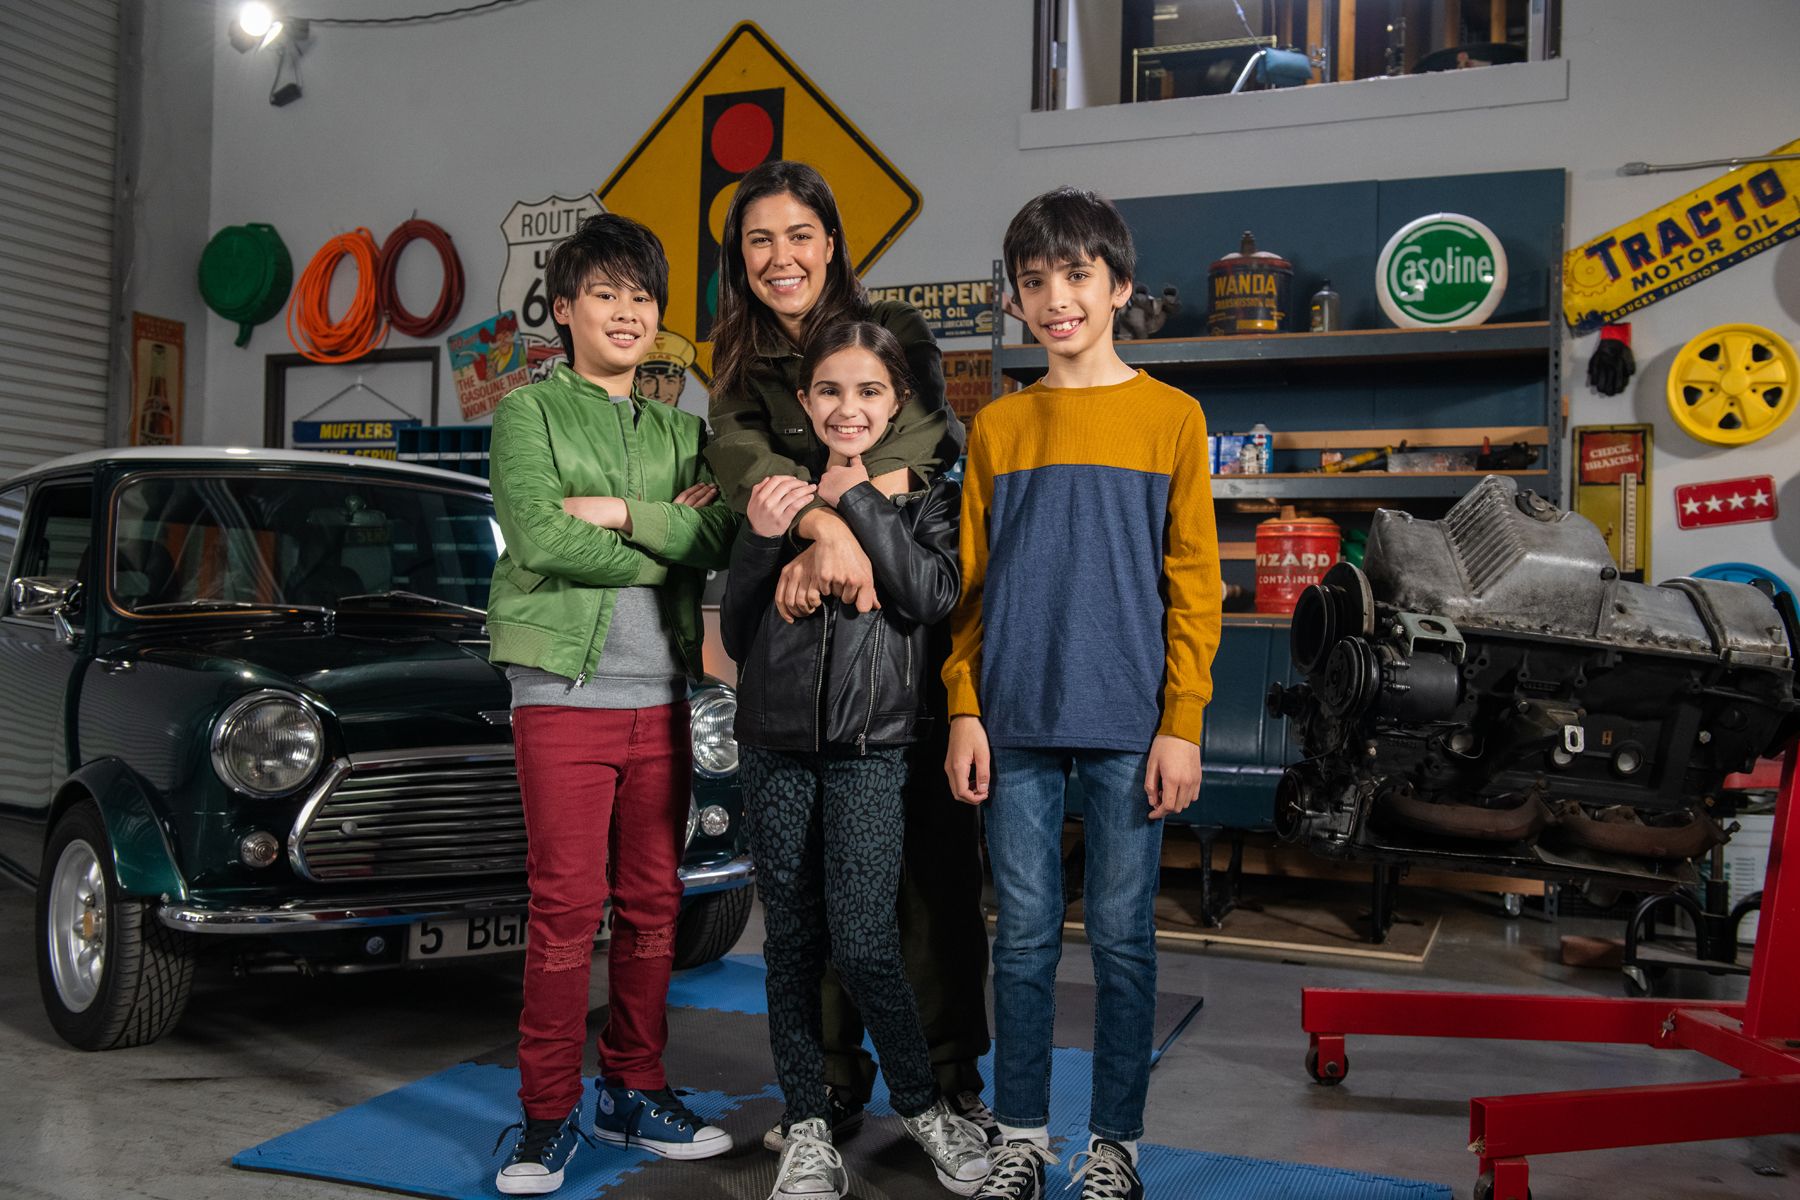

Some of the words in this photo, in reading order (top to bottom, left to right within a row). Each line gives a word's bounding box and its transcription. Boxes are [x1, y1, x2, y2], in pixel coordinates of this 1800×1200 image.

[1584, 168, 1787, 283] TRACTO
[1631, 238, 1725, 292] MOTOR
[1734, 214, 1779, 242] OIL
[1215, 273, 1277, 297] WANDA
[1390, 245, 1494, 302] Gasoline
[1603, 293, 1657, 323] REDUCES
[1663, 264, 1720, 295] FRICTION
[1741, 235, 1778, 257] SAVES
[946, 307, 968, 319] OIL
[457, 376, 475, 390] THE
[460, 379, 506, 404] GASOLINE
[507, 368, 528, 386] THAT
[463, 401, 487, 418] WON
[319, 422, 393, 440] MUFFLERS
[1589, 444, 1632, 459] CHECK
[1259, 575, 1319, 585] CONTAINER
[419, 921, 444, 955] 5
